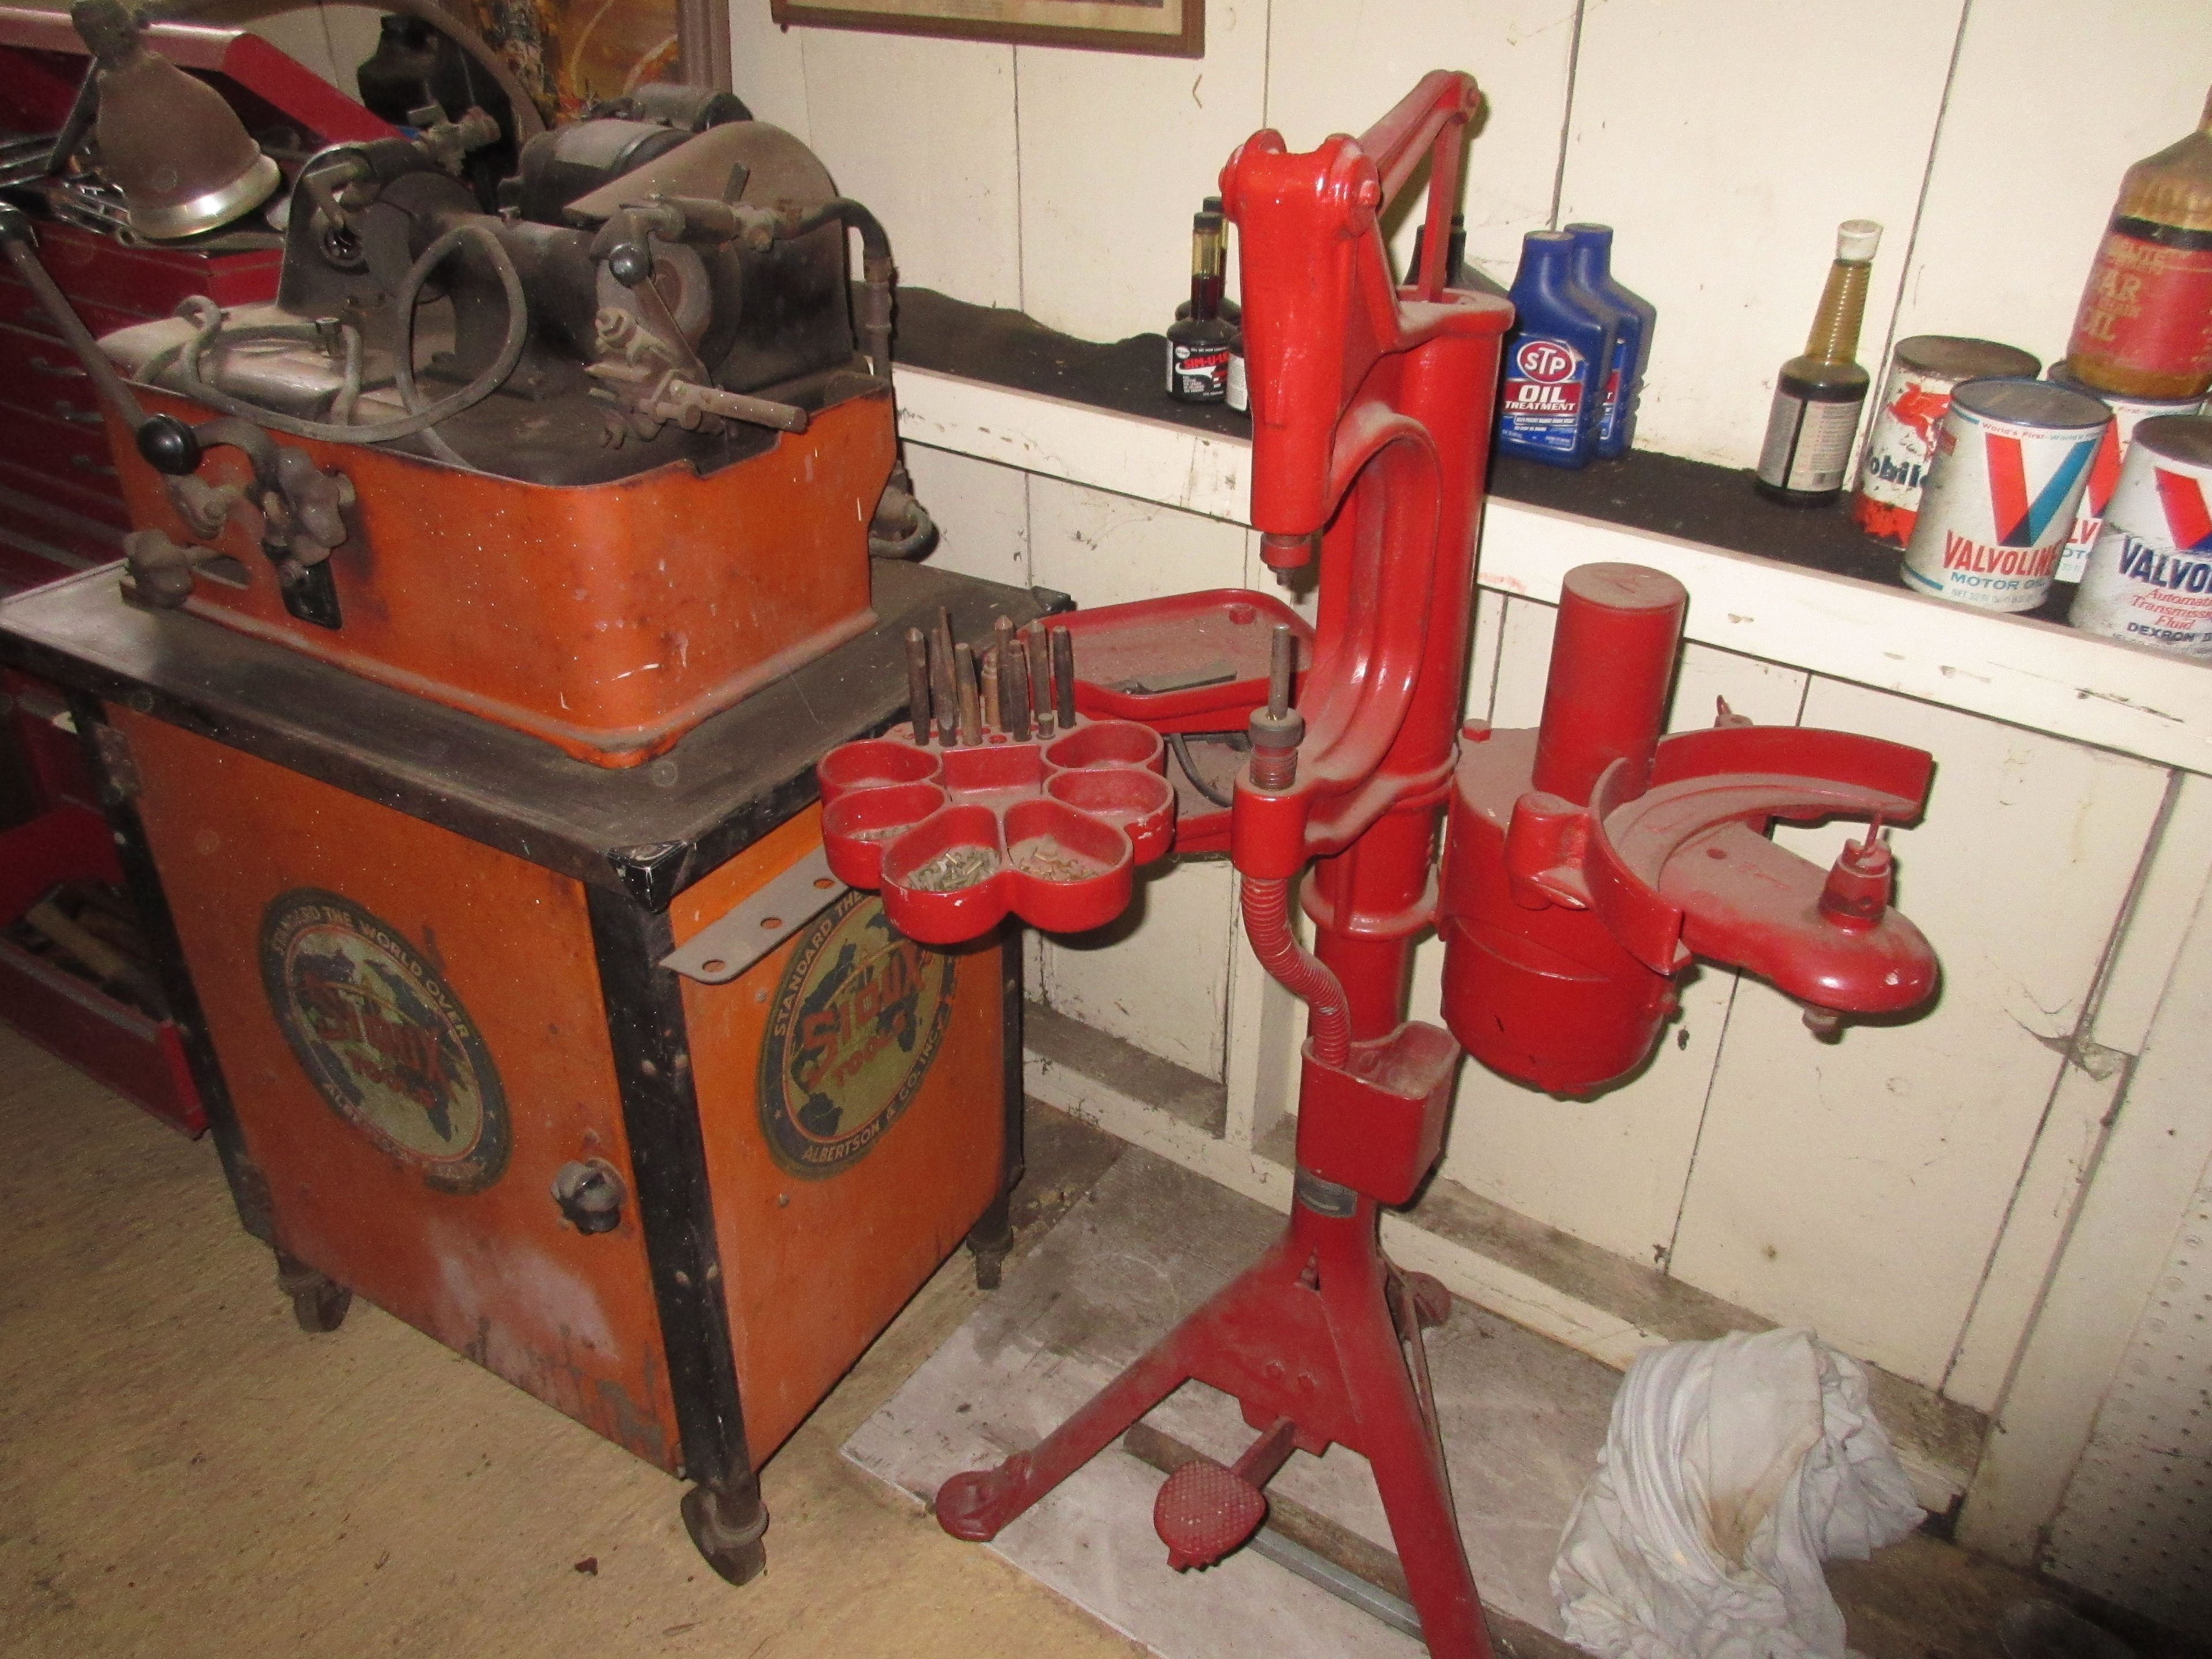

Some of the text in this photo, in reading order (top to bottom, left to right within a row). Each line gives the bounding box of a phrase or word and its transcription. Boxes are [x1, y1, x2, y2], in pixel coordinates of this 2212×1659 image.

[1525, 347, 1566, 374] STP
[1518, 384, 1566, 403] OIL
[1505, 401, 1575, 411] TREATMENT
[1869, 454, 1927, 488] obil
[2118, 535, 2212, 593] VALVO
[1951, 571, 2020, 590] MOTOR
[2127, 622, 2195, 642] DEXRON
[2154, 615, 2196, 630] Fluid
[774, 918, 833, 1036] STANDARD
[802, 1120, 880, 1162] ALBERTSON
